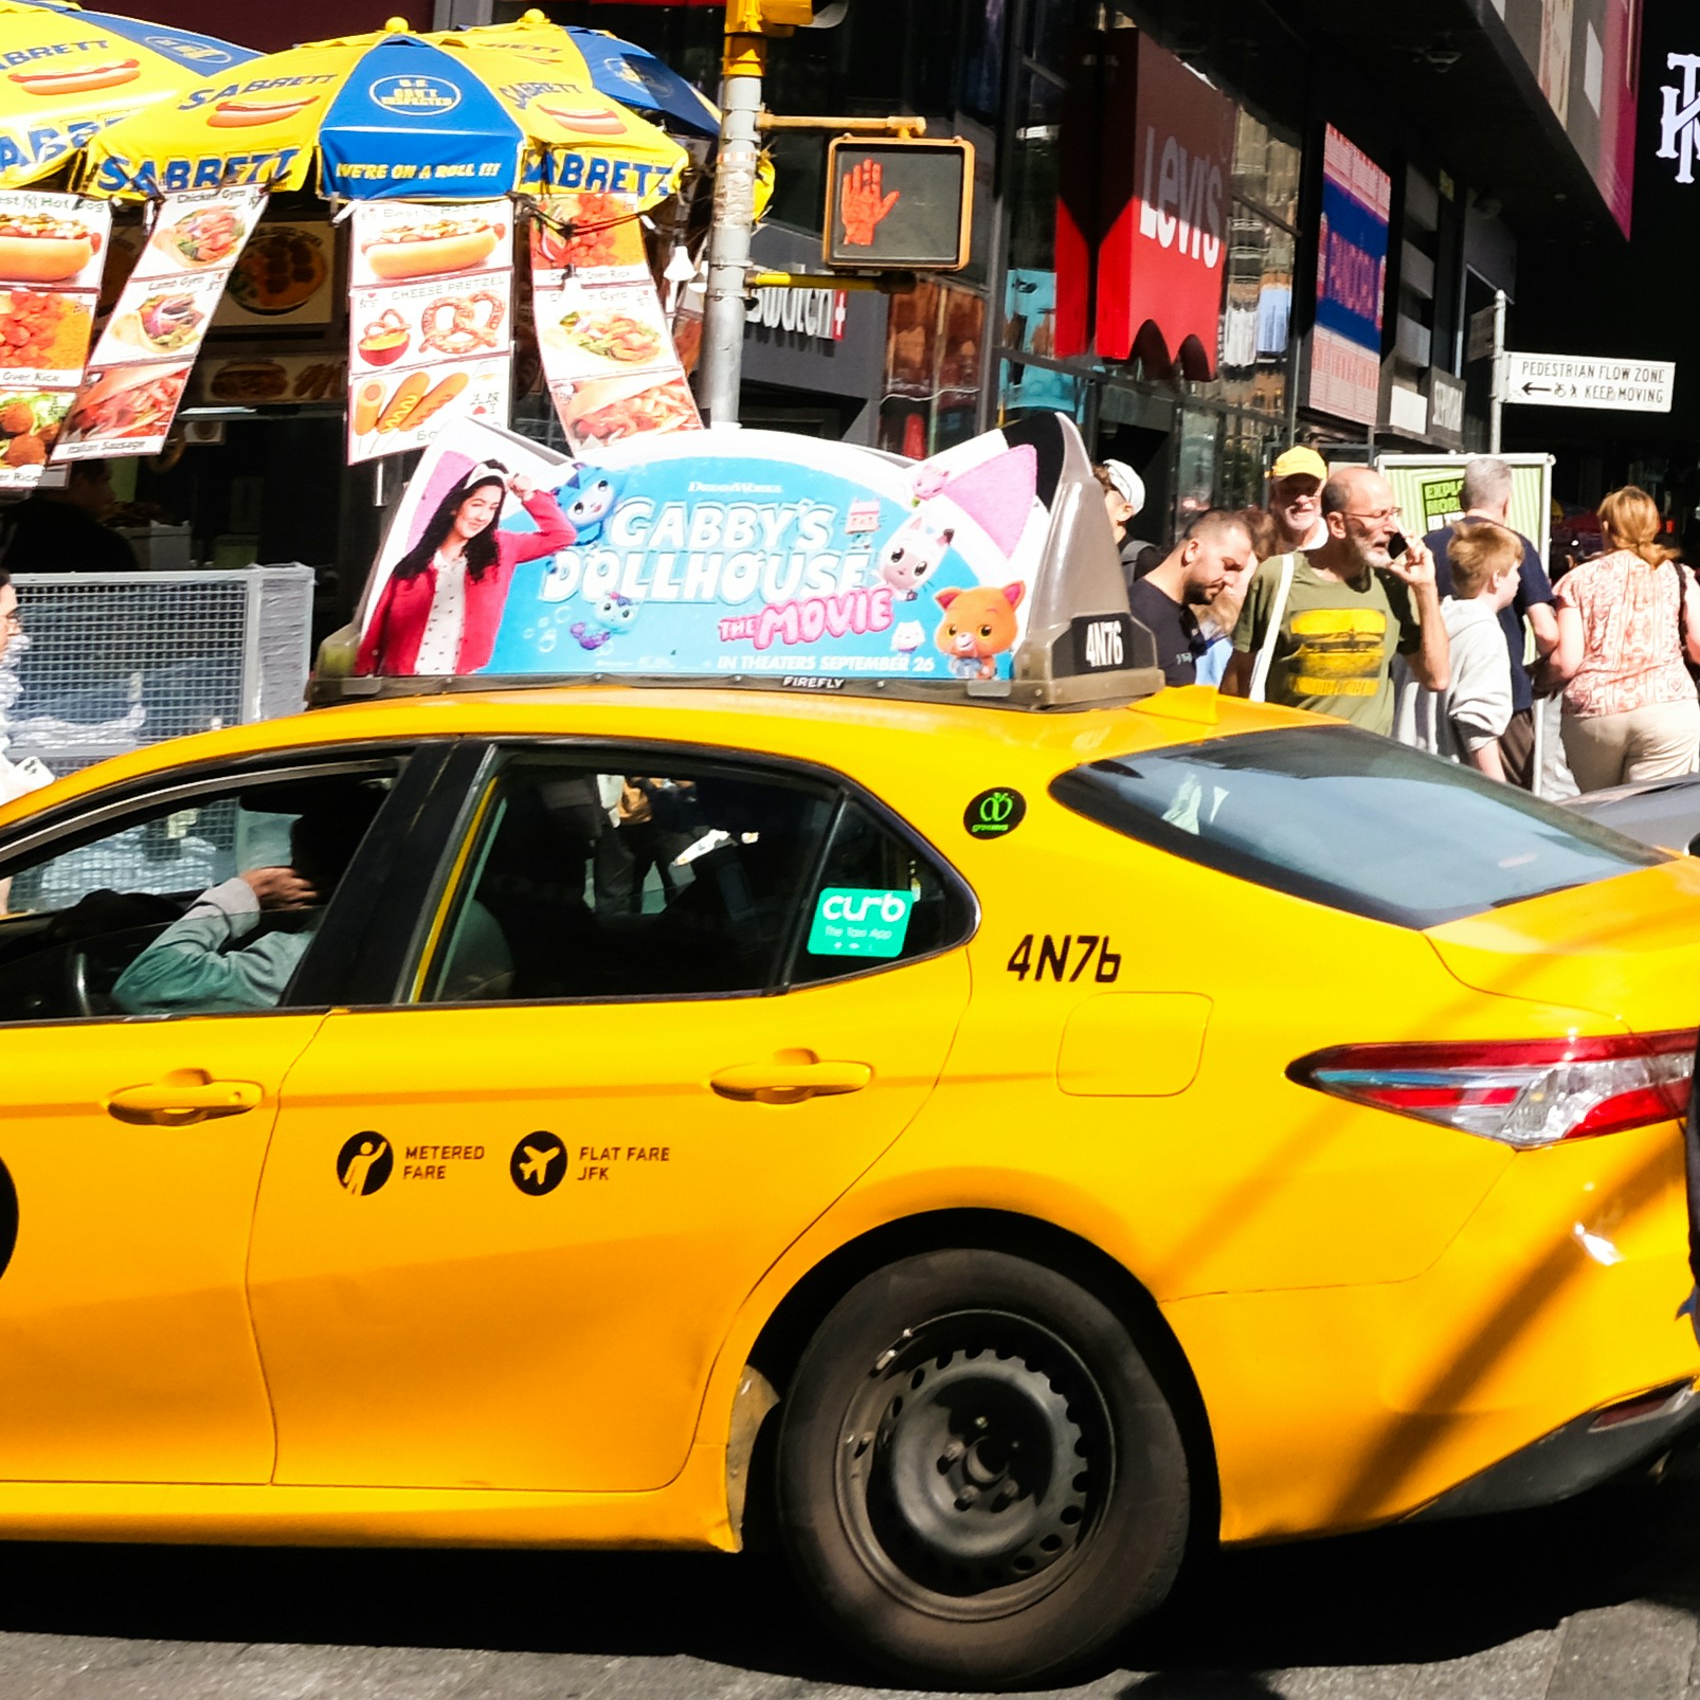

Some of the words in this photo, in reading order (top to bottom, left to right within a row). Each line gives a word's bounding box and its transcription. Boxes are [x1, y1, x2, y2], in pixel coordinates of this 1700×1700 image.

[177, 73, 338, 111] SABRETT
[522, 149, 674, 197] ABRETT
[1139, 126, 1223, 269] Levi's
[1521, 360, 1595, 379] PEDESTRIAN
[1599, 364, 1631, 381] FLOW
[1633, 366, 1666, 384] ZONE
[1584, 386, 1615, 401] KEEP
[1617, 387, 1665, 403] MOVING
[609, 499, 839, 550] GABBY'S
[541, 546, 876, 605] DOLLHOUSE
[717, 617, 758, 643] THE
[753, 588, 894, 650] MOVIE
[1084, 622, 1125, 668] 4N76
[717, 655, 738, 671] IN
[741, 655, 817, 672] THEATERS
[819, 654, 911, 673] SEPTEMBER
[912, 655, 935, 673] 26
[782, 675, 845, 690] FIREFLY
[821, 892, 906, 923] curb
[404, 1146, 486, 1163] METERED
[578, 1146, 624, 1163] FLAT
[625, 1147, 670, 1164] FARE
[402, 1164, 447, 1182] FARE
[577, 1165, 610, 1182] JFK
